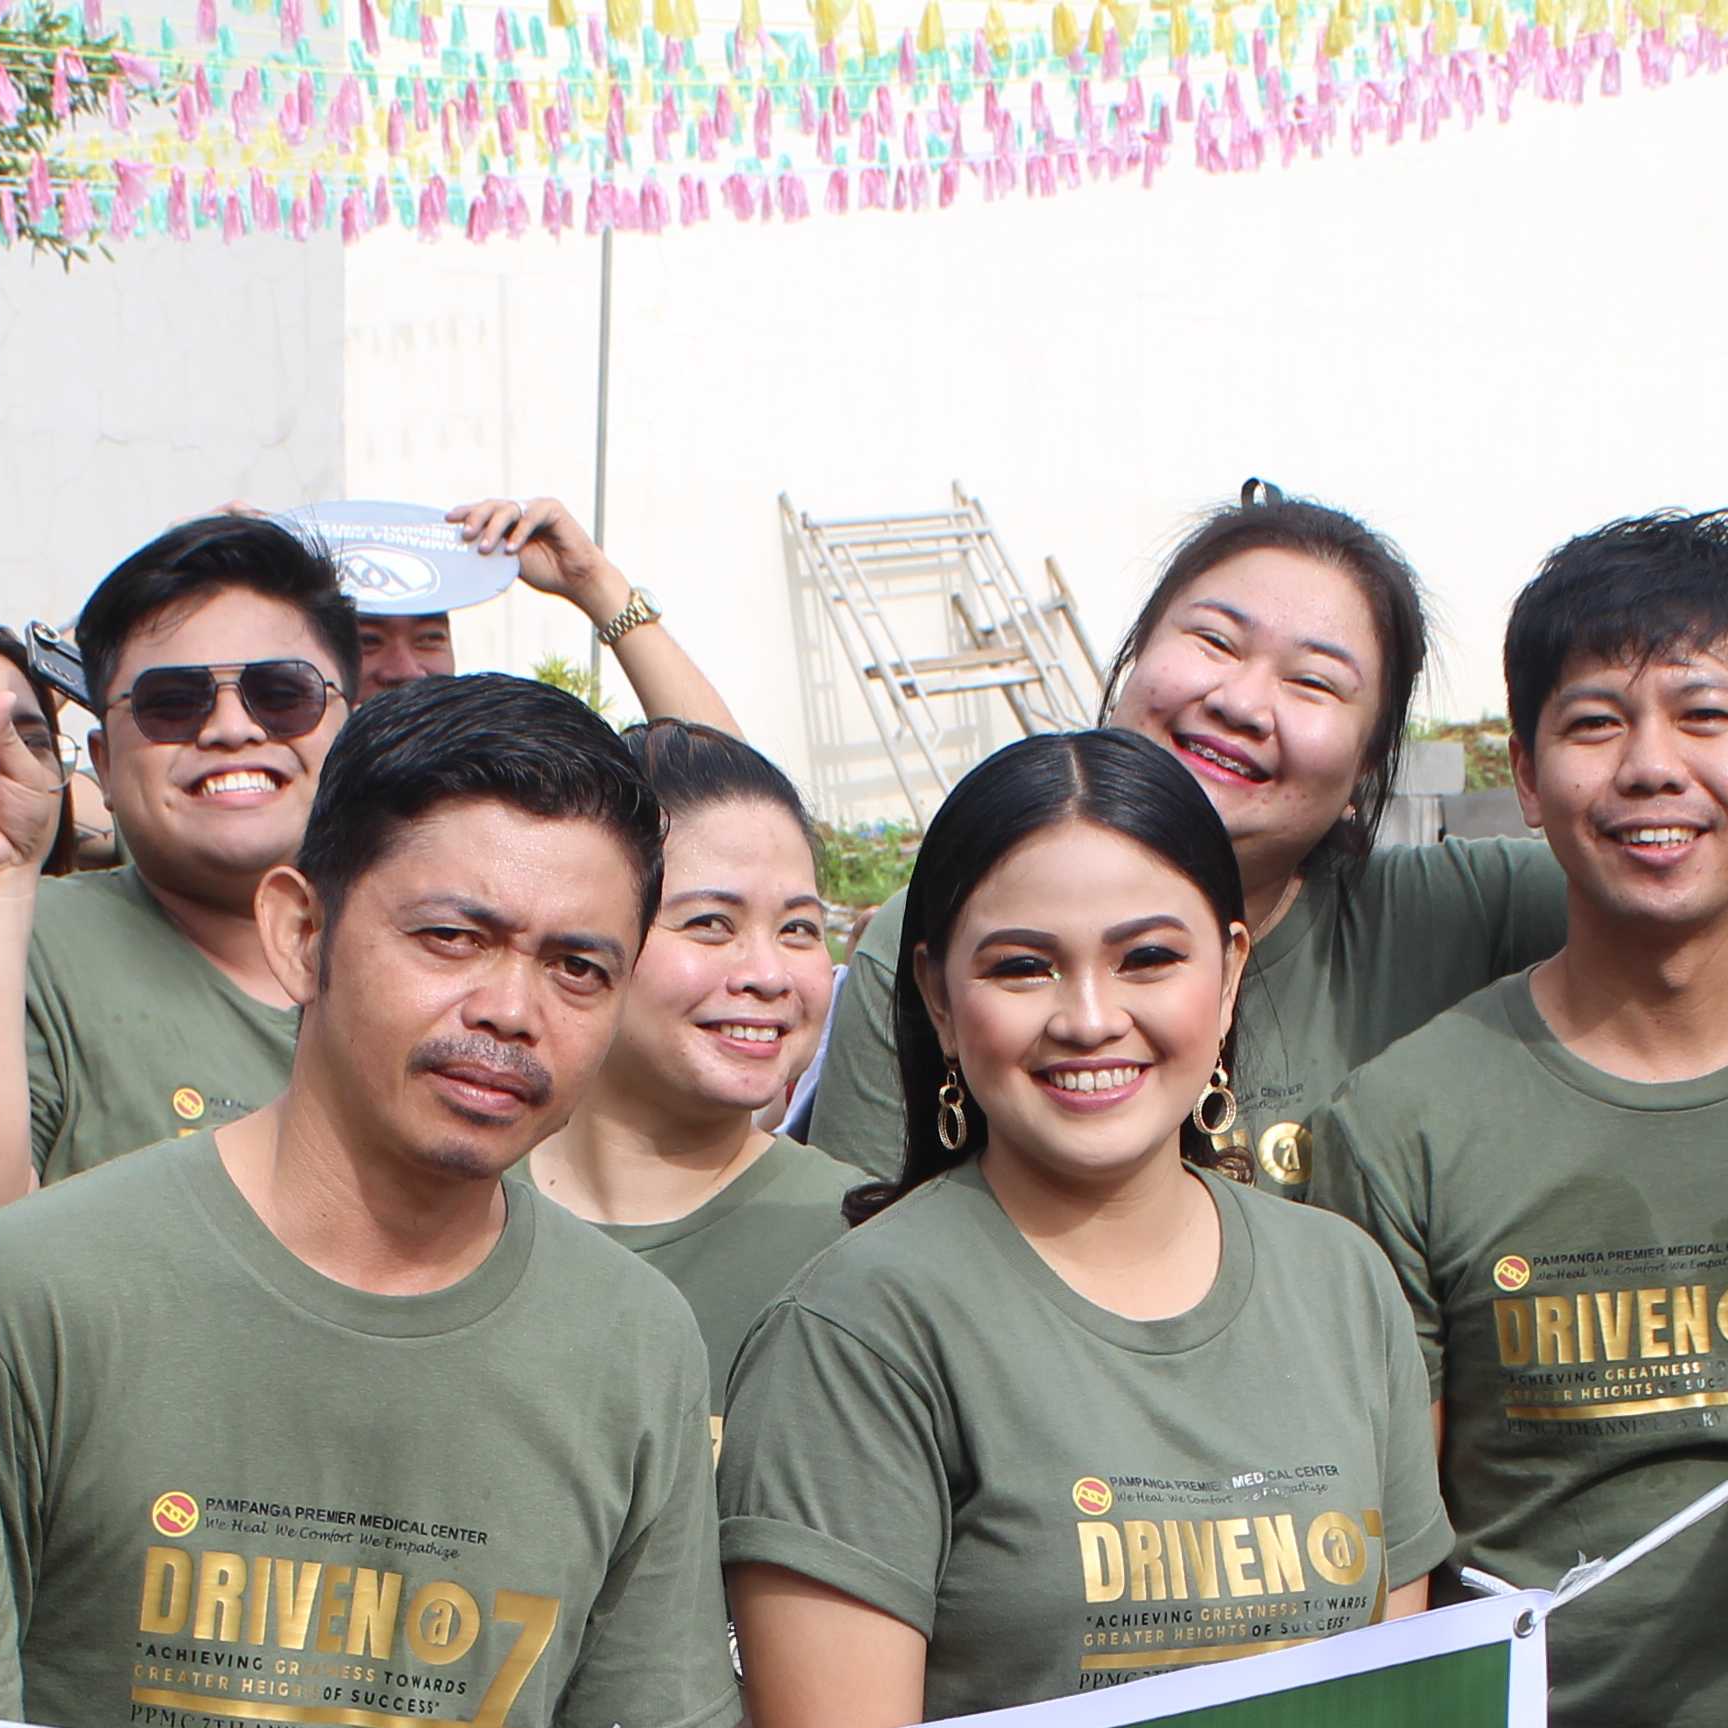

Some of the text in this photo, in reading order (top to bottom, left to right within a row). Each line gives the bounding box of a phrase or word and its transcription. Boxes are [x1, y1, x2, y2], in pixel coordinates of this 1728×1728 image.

[1533, 1253, 1605, 1267] PAMPANGA
[1607, 1248, 1664, 1261] PREMIER
[1667, 1243, 1721, 1258] MEDICAL
[1604, 1360, 1702, 1383] GREATNESS
[1581, 1382, 1656, 1399] HEIGHTS
[1109, 1475, 1173, 1492] PAMPANGA
[1174, 1479, 1229, 1493] PREMIE
[1295, 1464, 1340, 1479] CENTER
[1116, 1492, 1134, 1503] We
[1136, 1491, 1163, 1503] Heal
[1171, 1494, 1185, 1504] We
[1186, 1494, 1234, 1506] Comfort
[205, 1497, 489, 1546] PAMPANGA PREMIER MEDICAL CENTER
[205, 1517, 461, 1562] We Heal We Comfort We Empathize
[1200, 1601, 1298, 1622] GREATNESS
[1303, 1596, 1368, 1616] TOWARDS
[1083, 1629, 1165, 1647] GREATER
[1175, 1623, 1247, 1641] HEIGHTS
[1252, 1622, 1272, 1638] OF
[134, 1663, 229, 1692] GREATER
[324, 1686, 342, 1700] OF
[384, 1671, 467, 1696] TOWARDS
